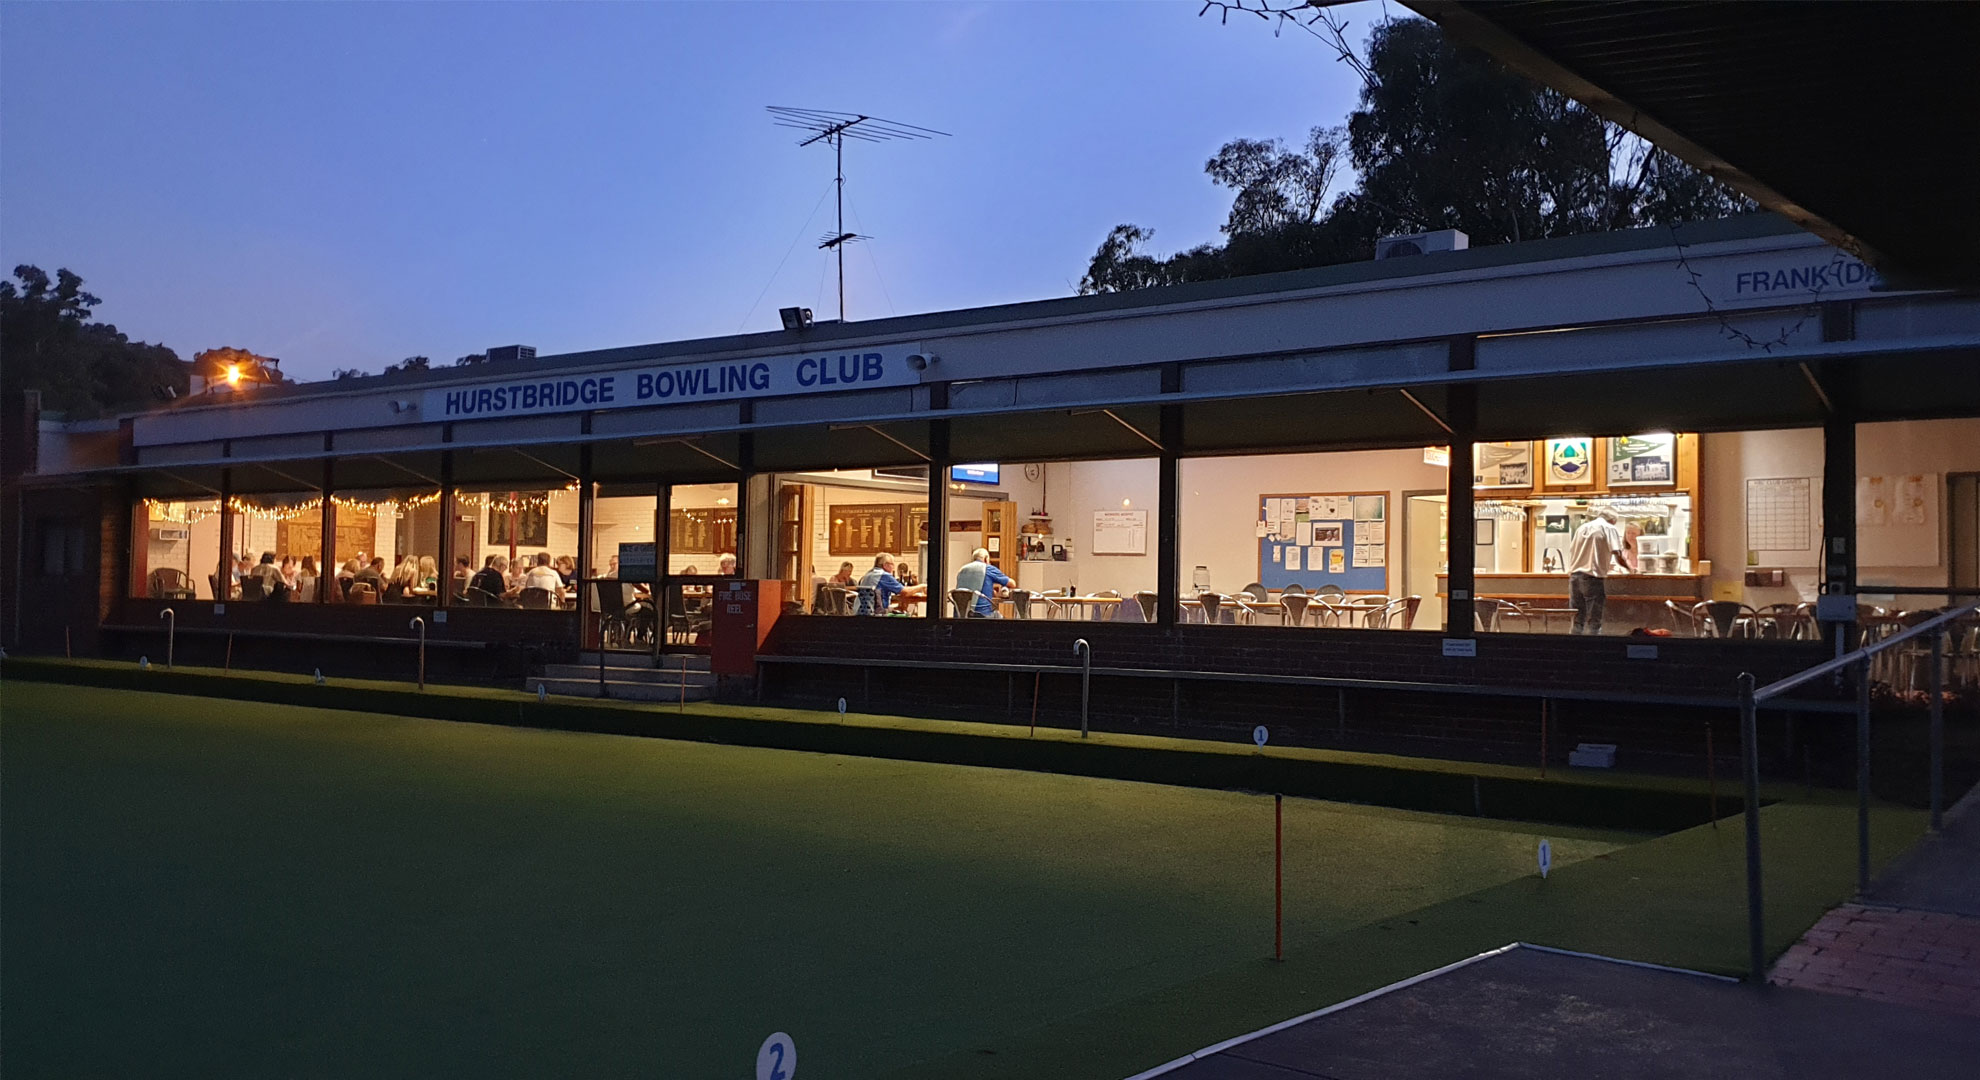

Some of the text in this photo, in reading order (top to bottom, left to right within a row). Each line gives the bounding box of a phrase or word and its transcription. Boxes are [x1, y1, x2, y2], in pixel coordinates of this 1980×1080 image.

[1736, 264, 1829, 293] FRANK
[445, 353, 884, 415] HURSTBRIDGE BOWLING CLUB
[718, 590, 752, 601] FIRE HOSE
[726, 603, 743, 614] REEL
[1258, 729, 1264, 741] 1
[1541, 845, 1547, 866] 1
[769, 1042, 786, 1080] 2
